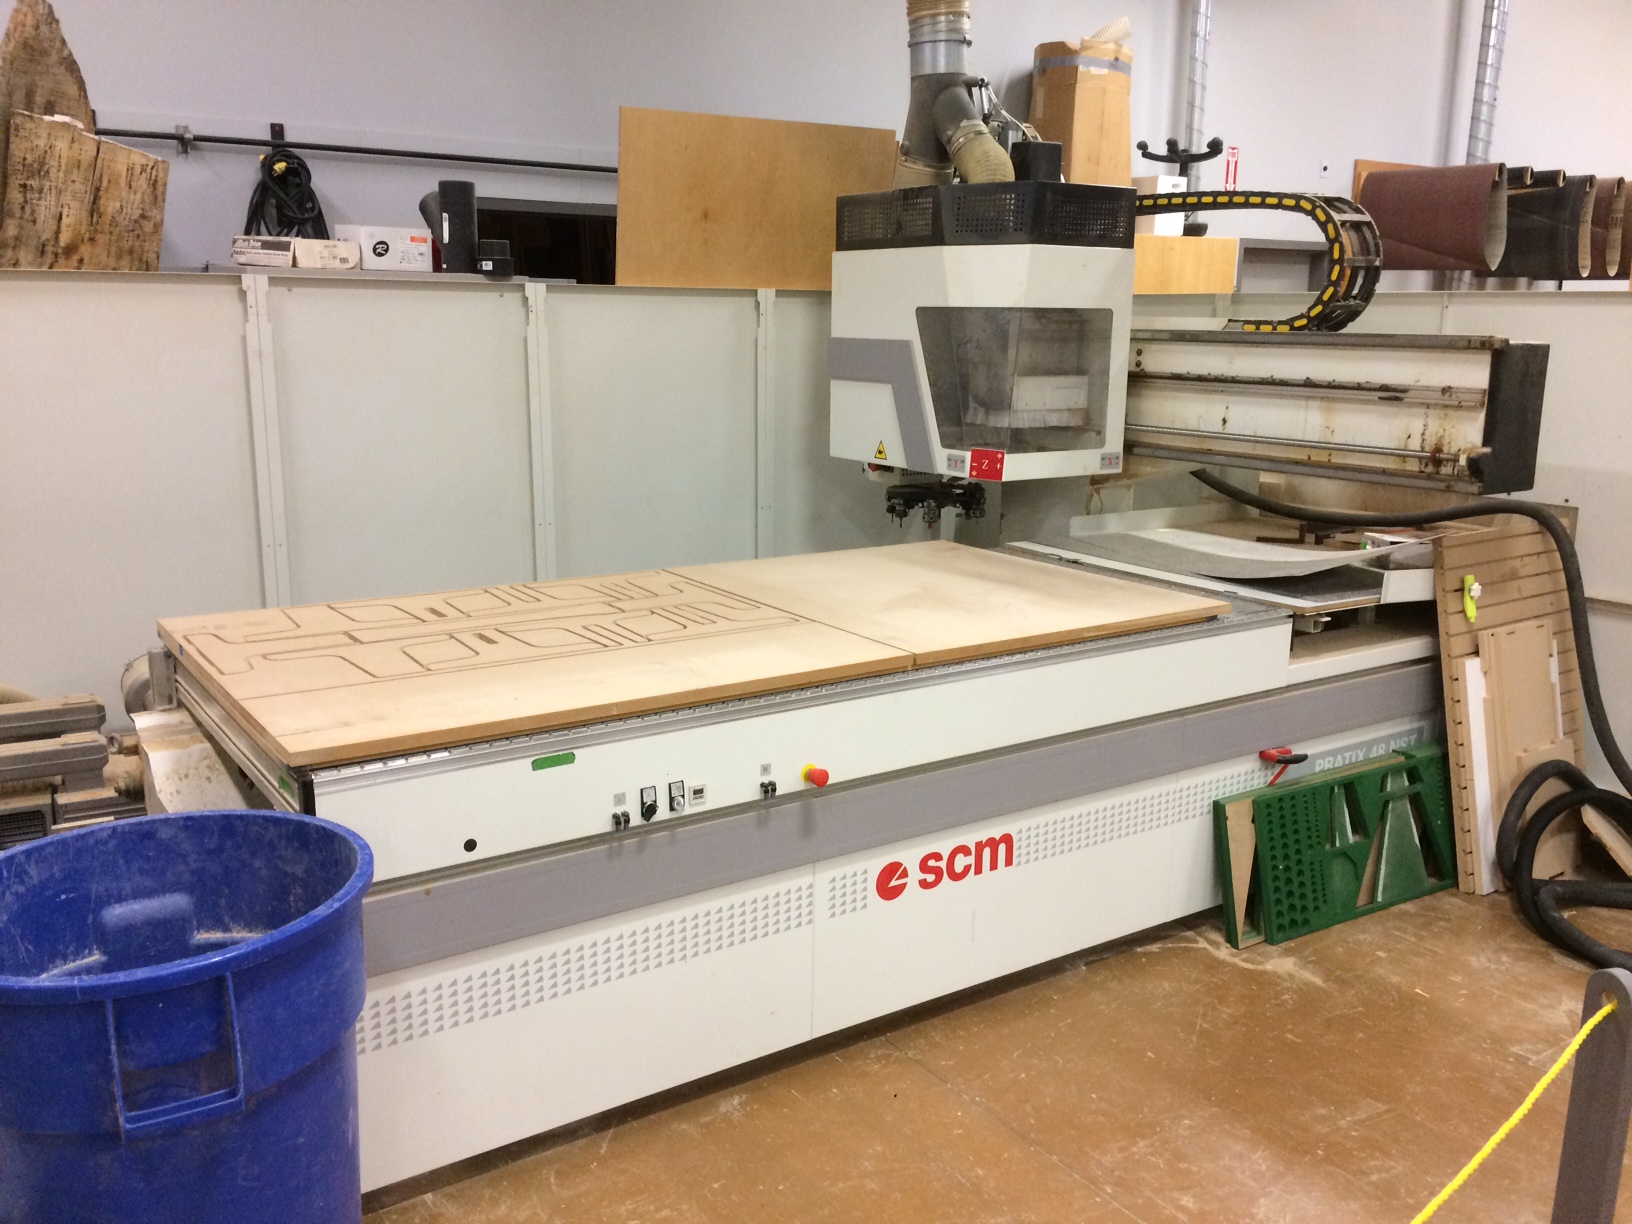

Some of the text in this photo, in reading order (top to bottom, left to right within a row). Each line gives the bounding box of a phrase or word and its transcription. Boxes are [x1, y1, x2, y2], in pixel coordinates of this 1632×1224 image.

[981, 459, 989, 470] Z
[1315, 734, 1418, 773] PRATIX 48 NST
[917, 832, 1014, 890] scm
